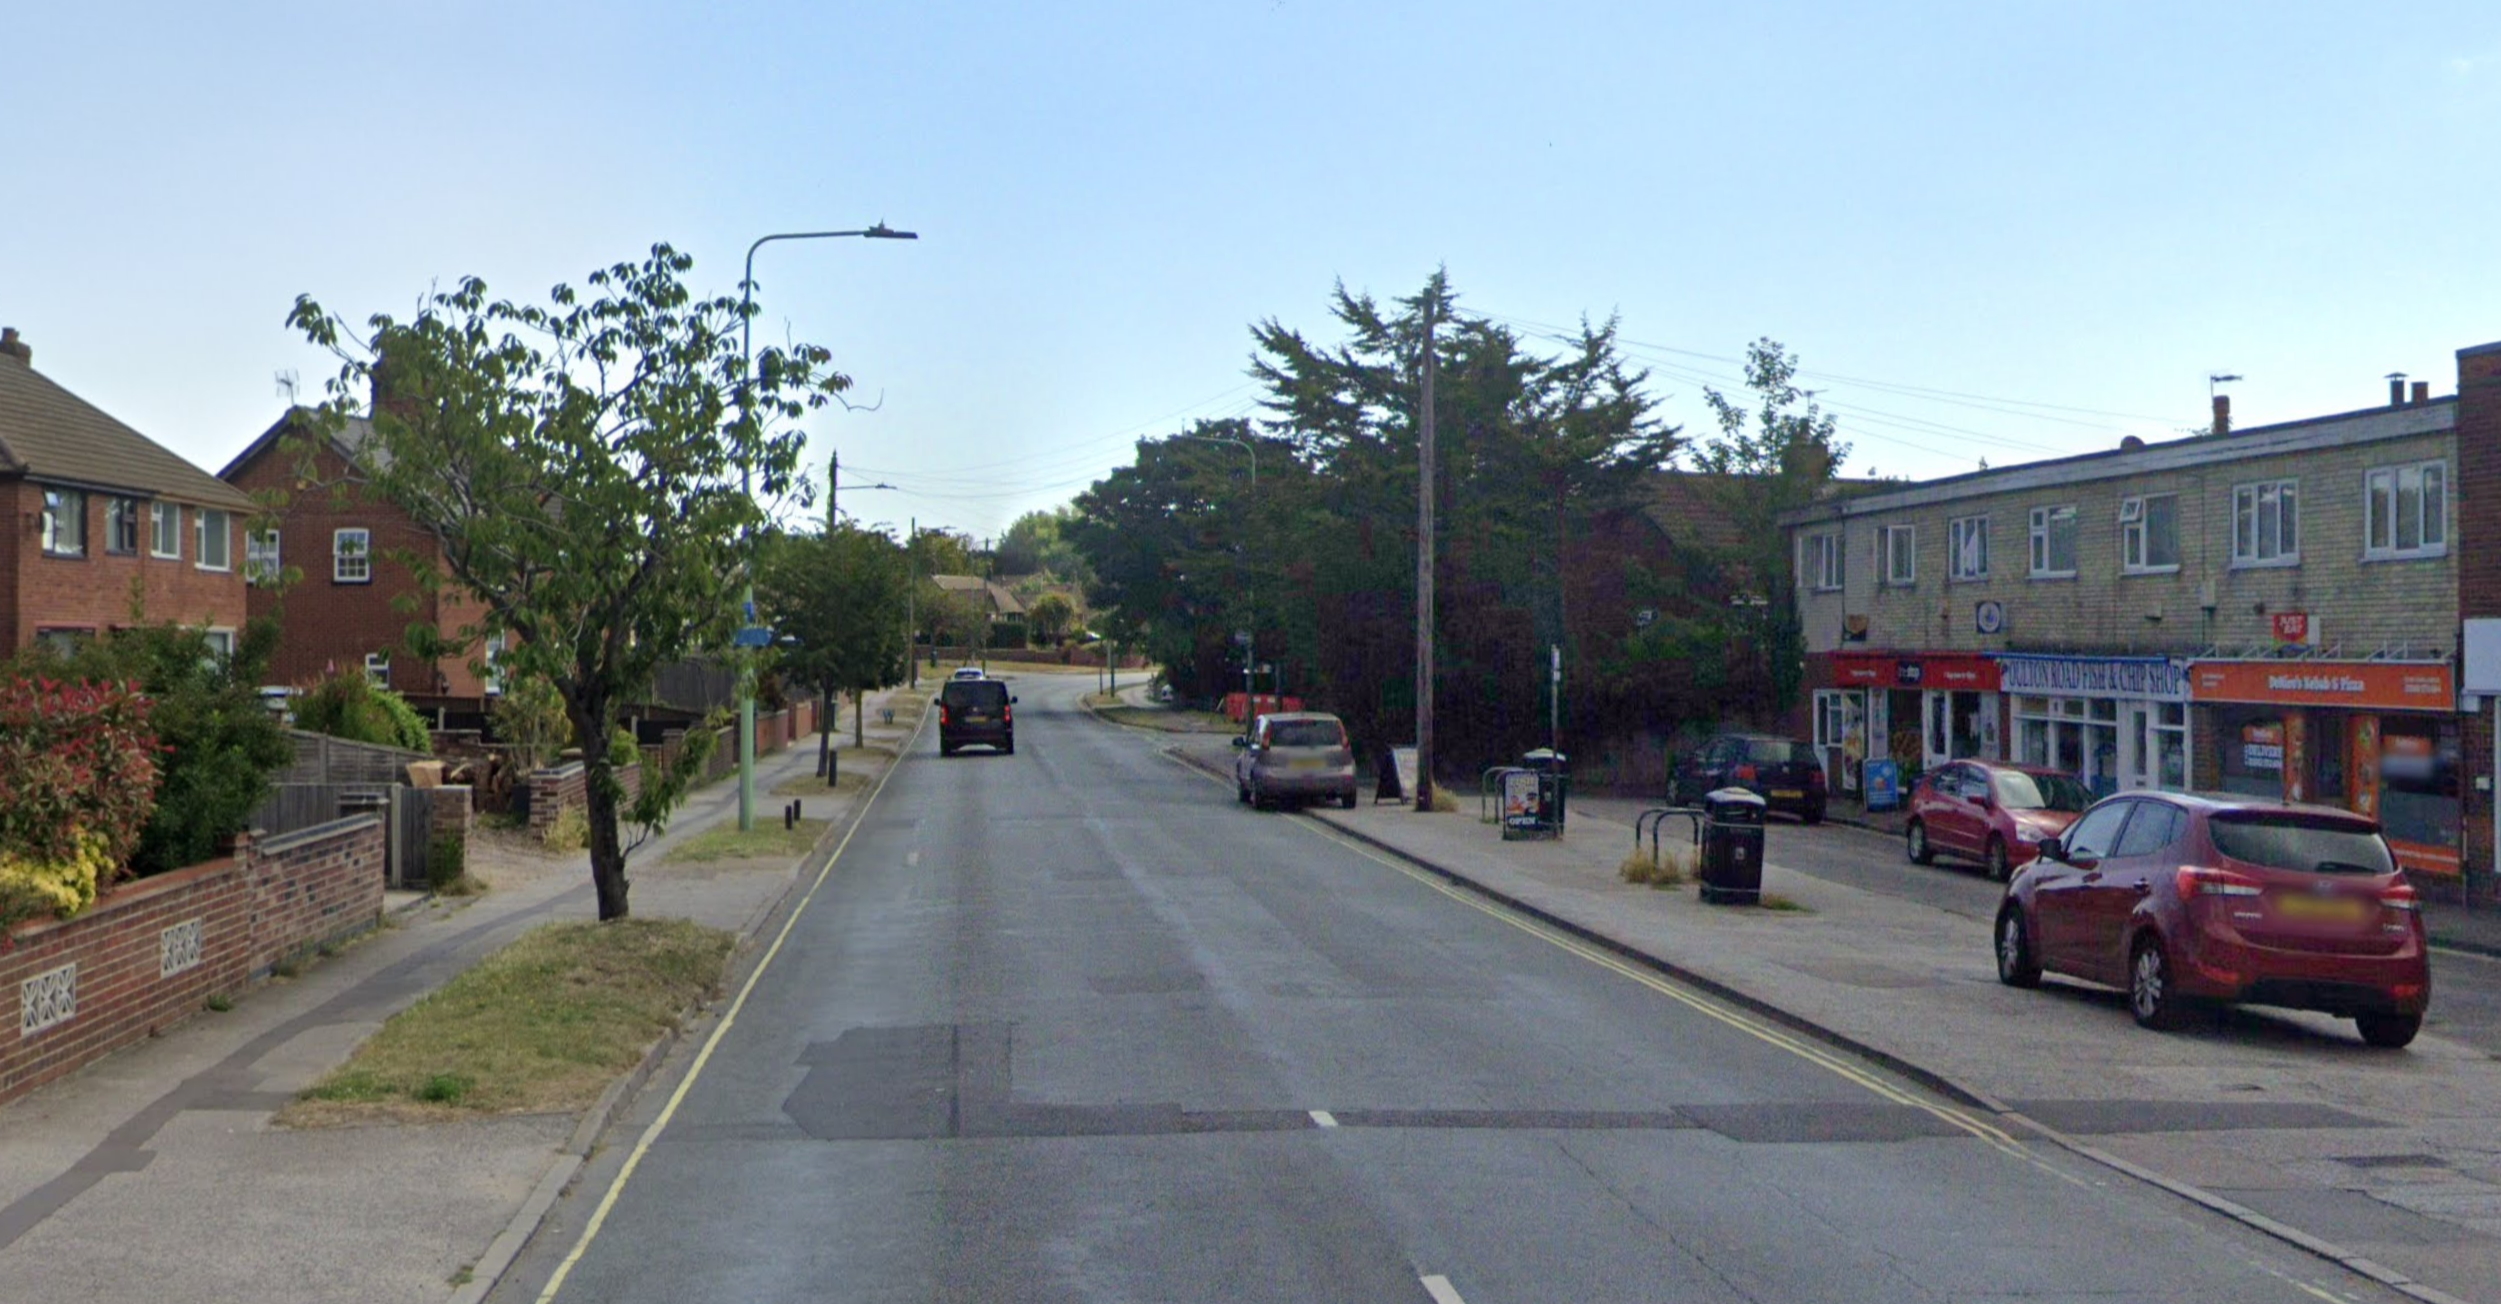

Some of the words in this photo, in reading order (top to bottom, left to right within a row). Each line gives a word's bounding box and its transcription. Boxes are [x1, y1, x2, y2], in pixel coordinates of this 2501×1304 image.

[2279, 615, 2304, 626] JUST
[2283, 624, 2303, 634] EAT
[2009, 660, 2049, 687] OULTON
[2051, 661, 2080, 689] ROAD
[2083, 663, 2106, 690] FISH
[2108, 664, 2118, 690] &
[2119, 664, 2146, 692] CHIP
[2149, 664, 2181, 694] SHOP
[2303, 675, 2331, 691] Kebab
[2340, 676, 2364, 691] Pizza
[1509, 816, 1536, 825] OPEN
